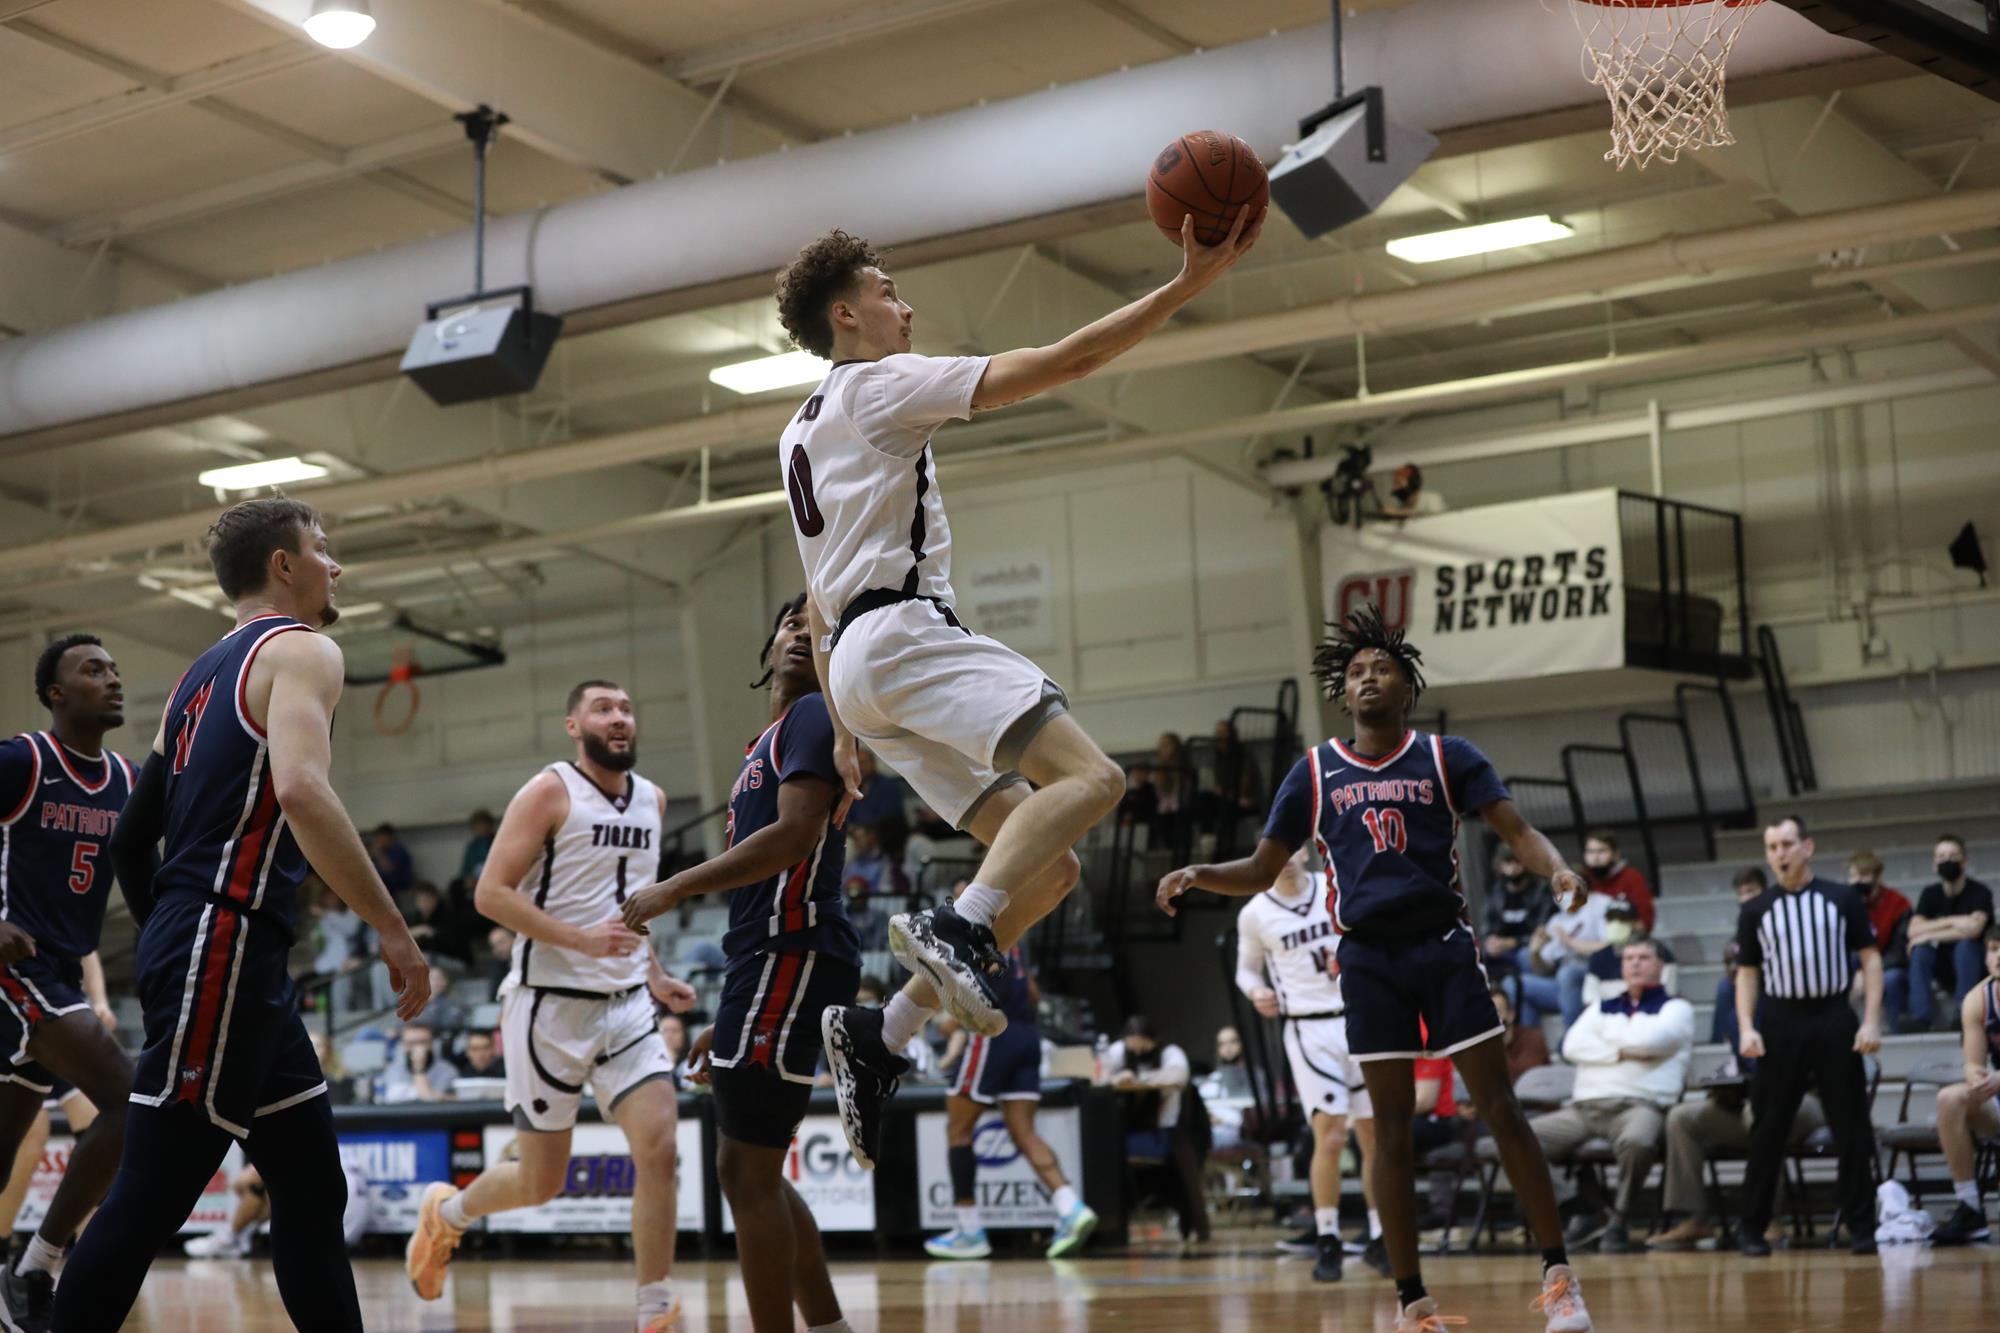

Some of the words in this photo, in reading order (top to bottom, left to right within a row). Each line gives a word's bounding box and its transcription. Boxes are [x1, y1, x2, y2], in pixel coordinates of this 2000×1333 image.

[1435, 546, 1606, 598] SPORTS
[1337, 571, 1415, 635] CU
[1433, 582, 1613, 634] NETWORK
[41, 801, 119, 838] PATRIOT
[1331, 779, 1433, 816] PATRIOTS
[591, 824, 653, 850] TIGERS
[1362, 807, 1407, 854] 10
[68, 840, 99, 894] 5
[1281, 921, 1330, 951] TIGER
